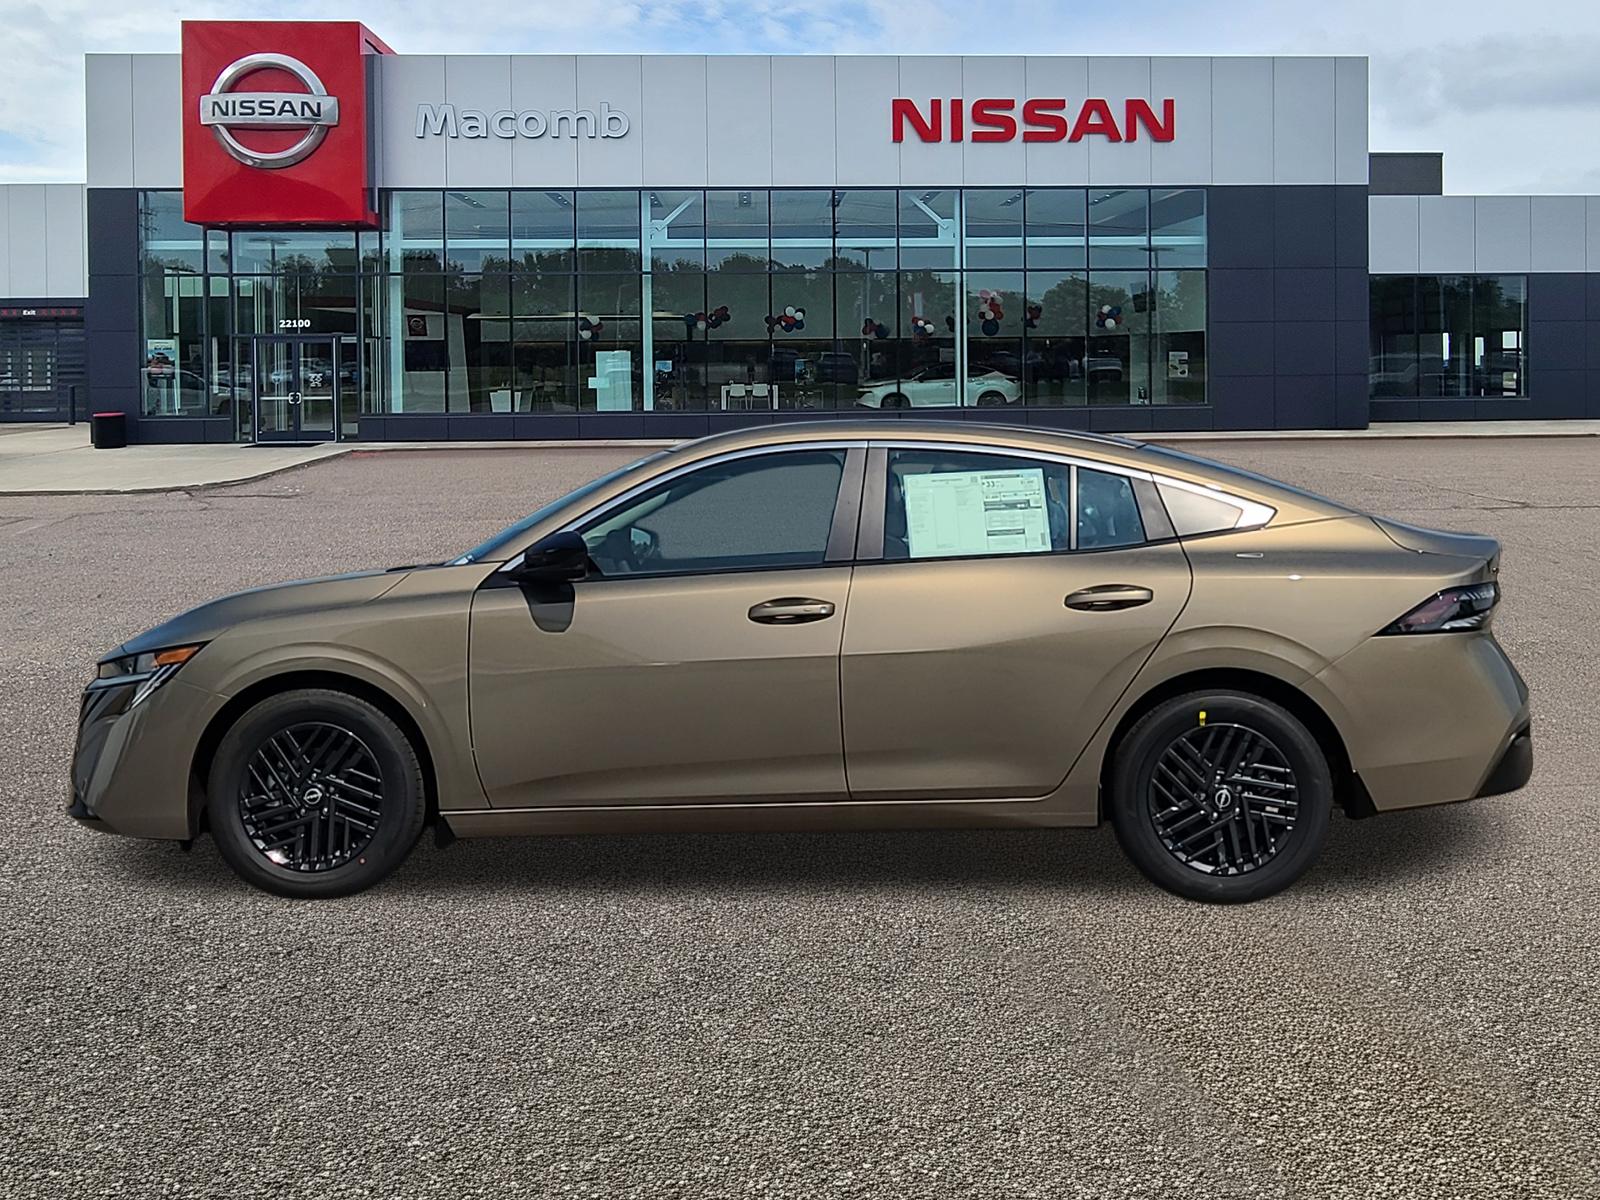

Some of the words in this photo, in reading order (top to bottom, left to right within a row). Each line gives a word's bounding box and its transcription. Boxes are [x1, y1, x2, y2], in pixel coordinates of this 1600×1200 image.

[212, 100, 321, 117] NISSAN
[415, 102, 630, 138] Macomb
[892, 98, 1175, 143] NISSAN
[279, 319, 311, 328] 22100
